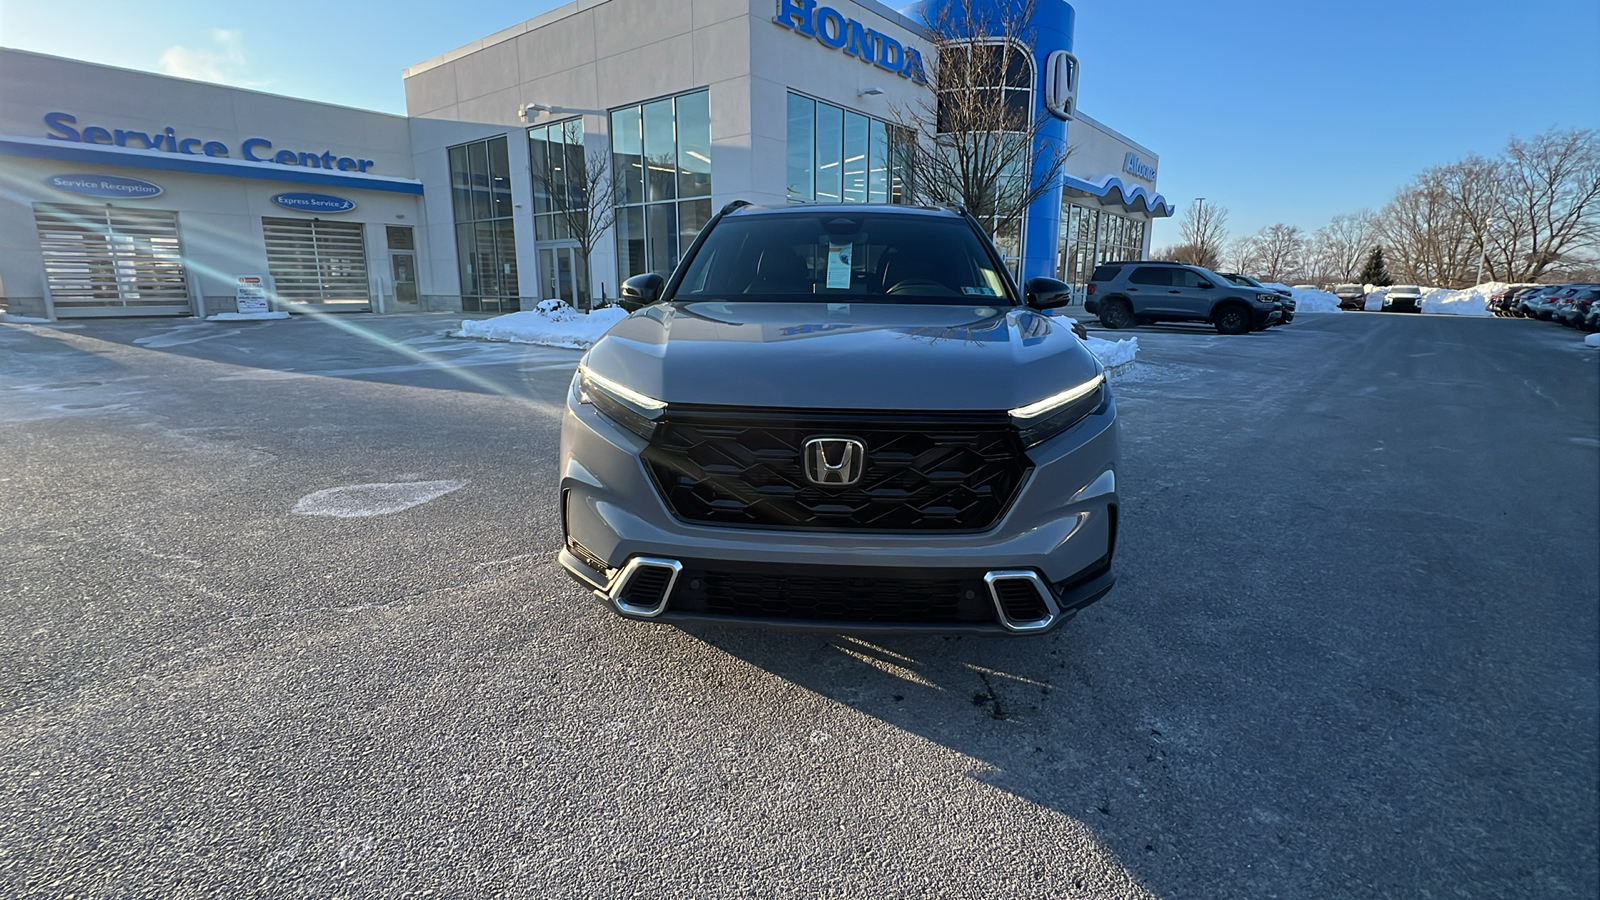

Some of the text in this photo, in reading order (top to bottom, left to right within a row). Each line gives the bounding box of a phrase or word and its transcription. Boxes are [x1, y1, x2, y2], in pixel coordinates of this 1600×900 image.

[772, 0, 928, 86] HONDA
[44, 112, 374, 173] Service Center
[53, 177, 156, 193] Service Reception
[278, 196, 340, 207] Express Service
